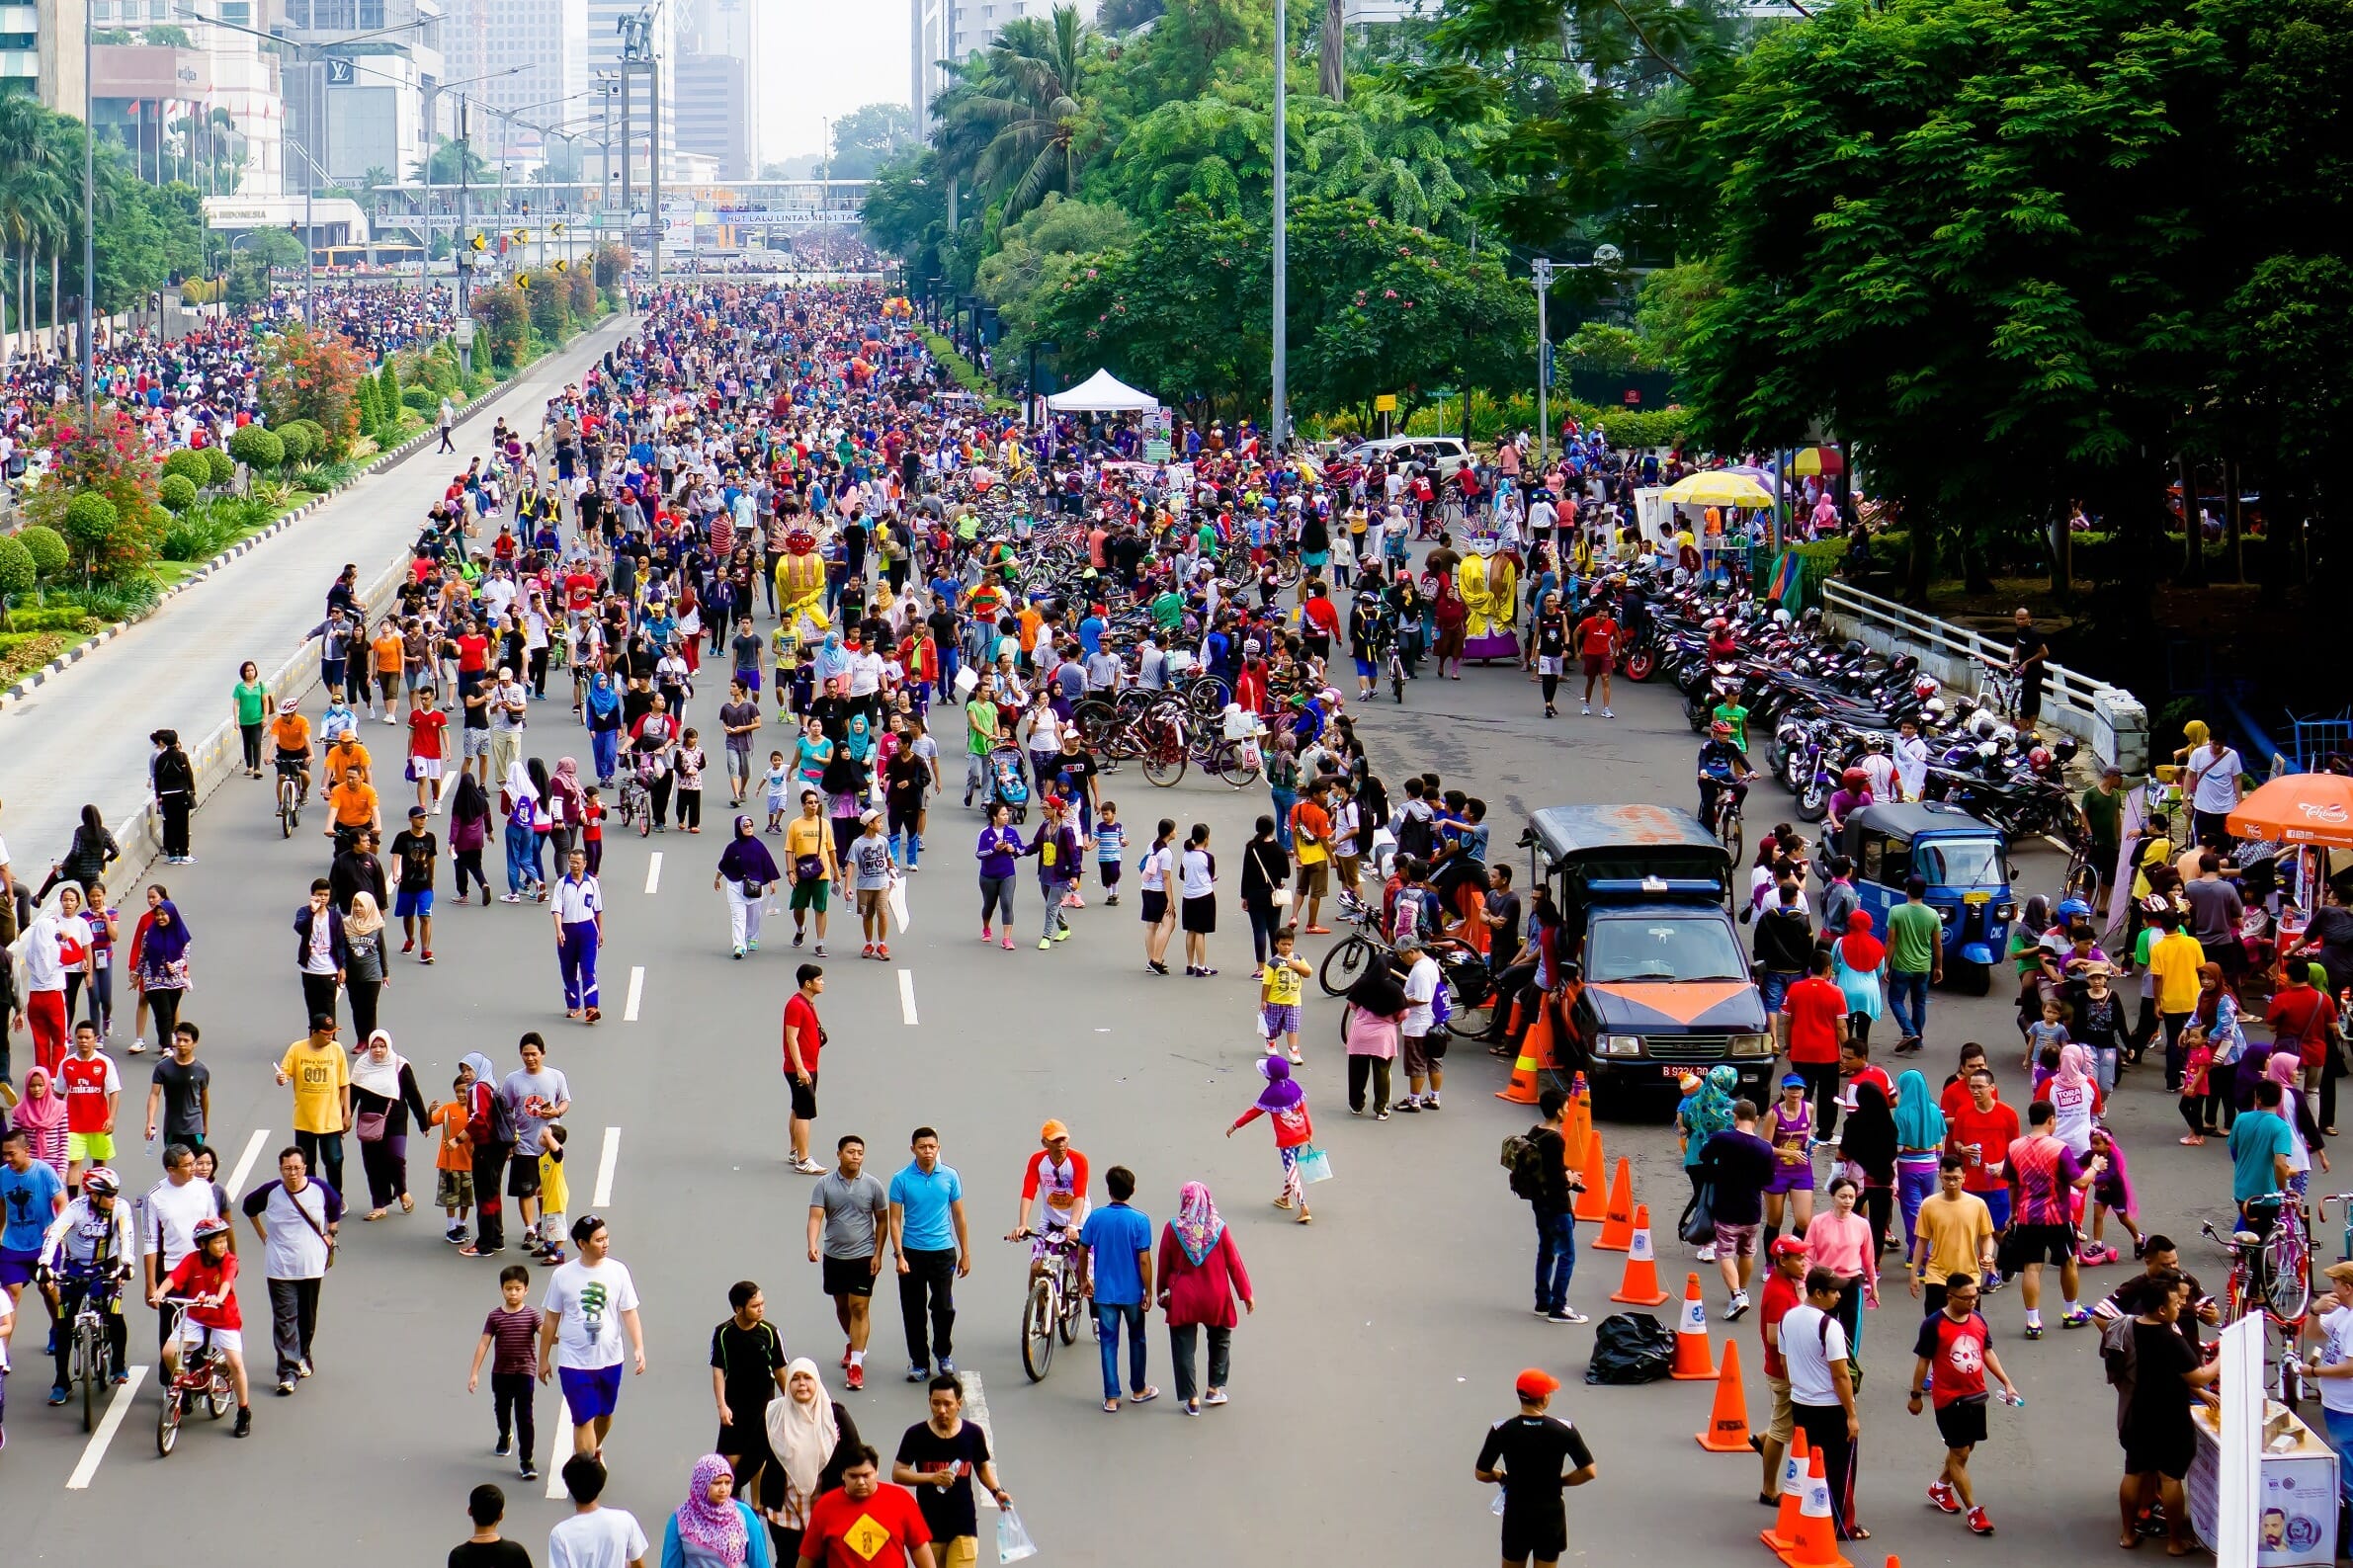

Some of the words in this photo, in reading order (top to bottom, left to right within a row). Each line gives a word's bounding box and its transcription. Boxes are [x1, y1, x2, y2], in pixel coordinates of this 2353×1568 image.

[78, 1078, 89, 1087] Fly
[69, 1085, 103, 1094] Emirates
[2058, 1088, 2081, 1098] TORA
[2060, 1096, 2082, 1106] BIKA
